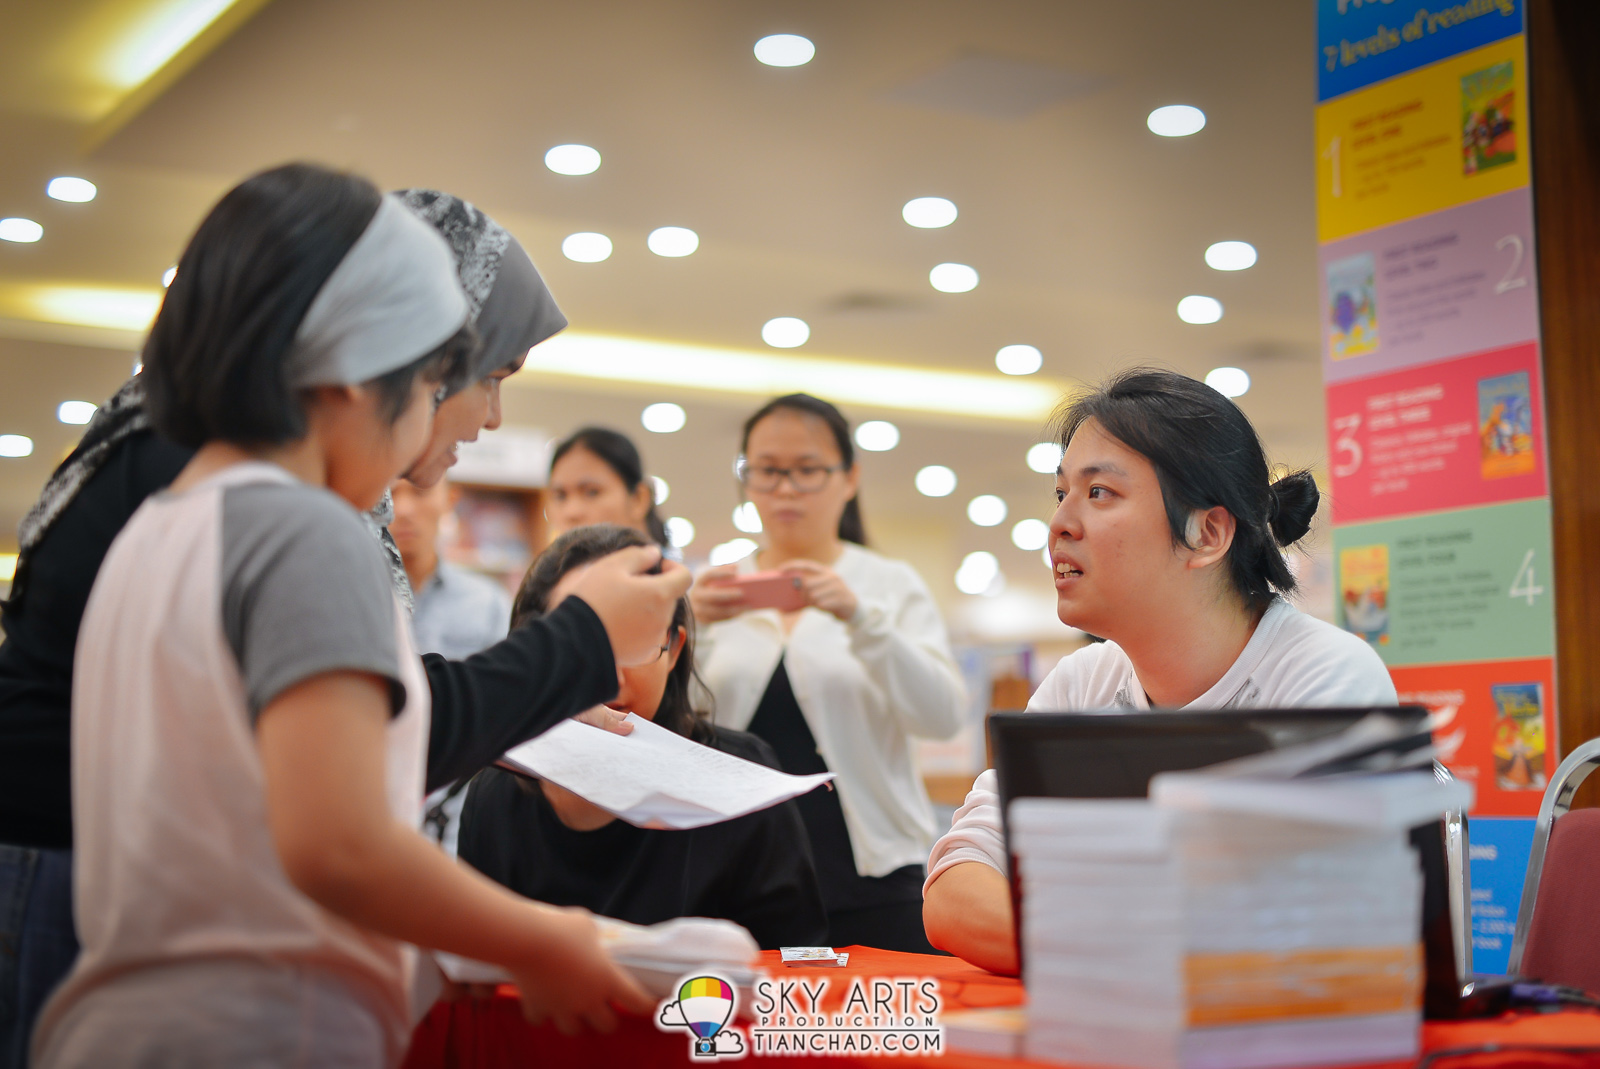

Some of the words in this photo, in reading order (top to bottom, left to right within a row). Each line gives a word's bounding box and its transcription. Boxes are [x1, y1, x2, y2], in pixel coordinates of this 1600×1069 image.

[1323, 45, 1339, 72] 7
[1340, 24, 1401, 67] levels
[1402, 8, 1429, 42] of
[1427, 0, 1515, 34] reading
[1322, 135, 1342, 198] 1
[1495, 234, 1527, 294] 2
[1334, 413, 1363, 477] 3
[1509, 549, 1544, 606] 4
